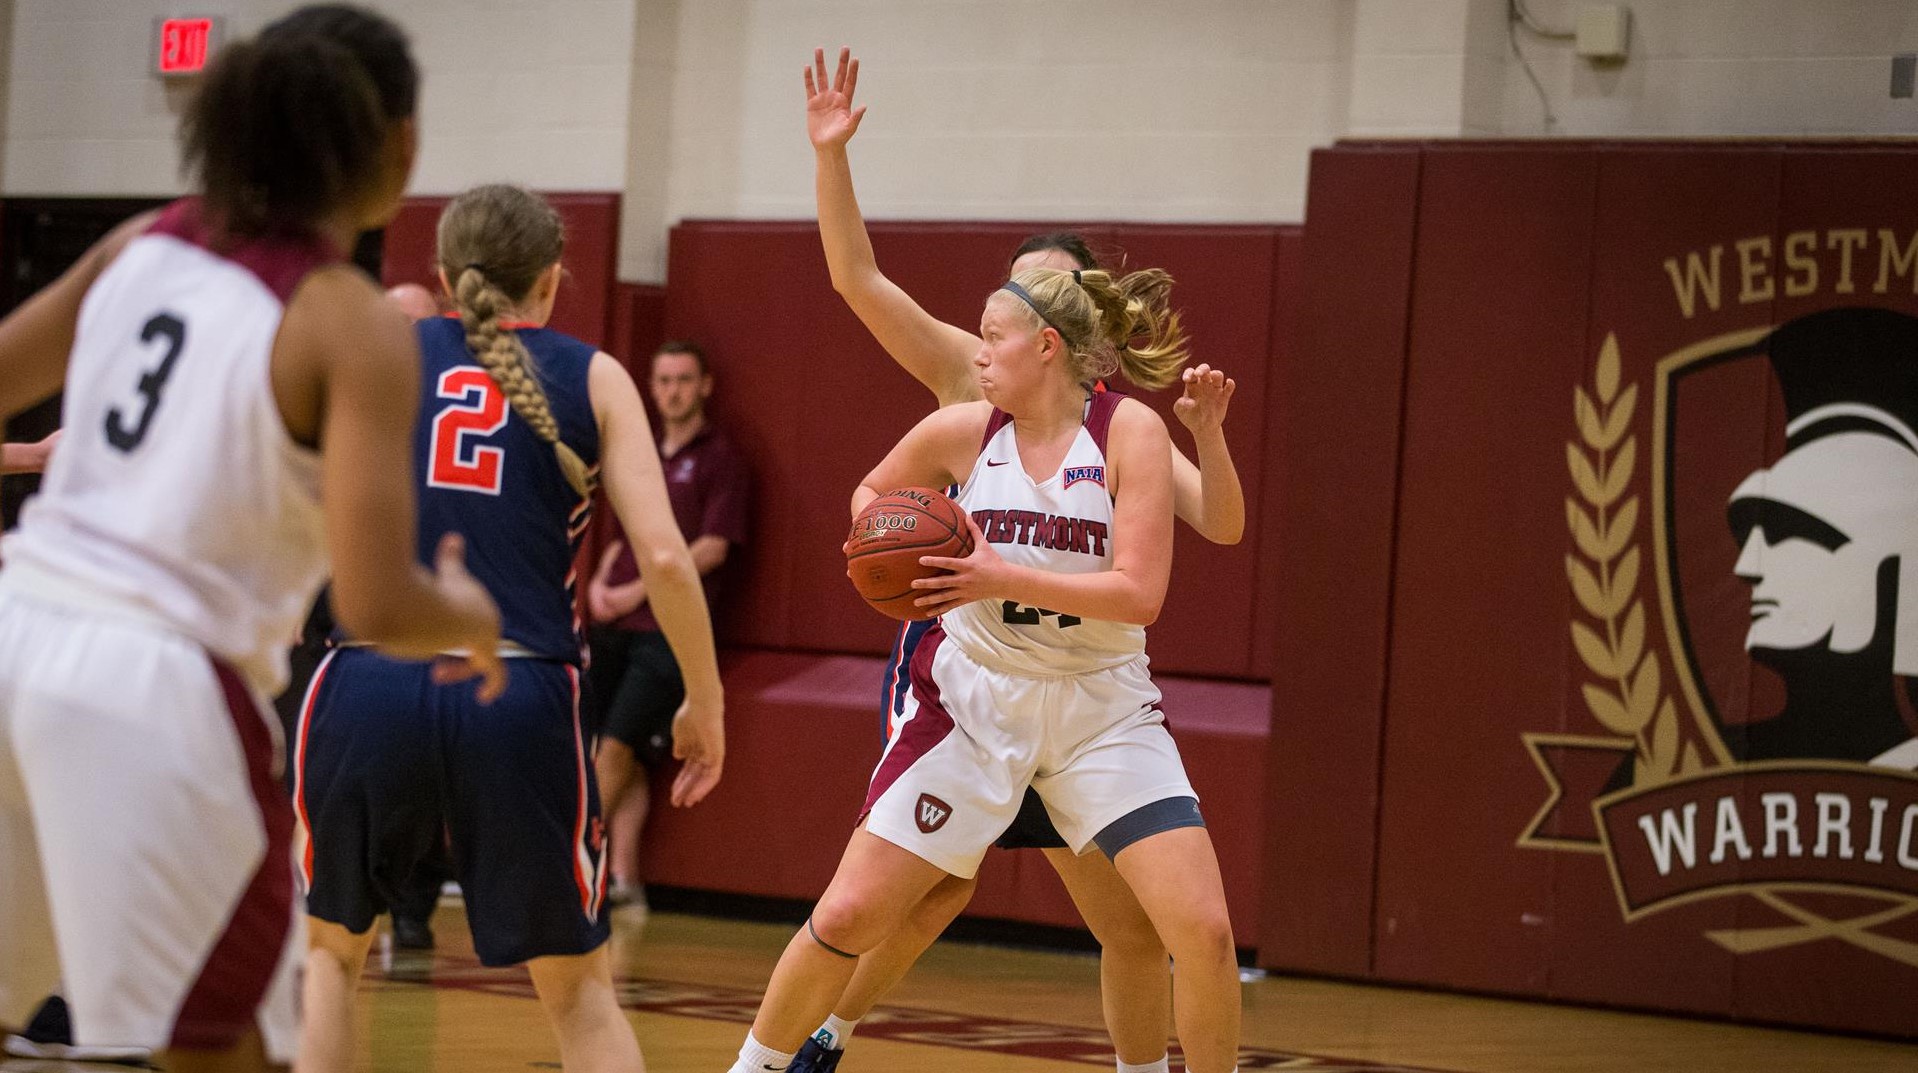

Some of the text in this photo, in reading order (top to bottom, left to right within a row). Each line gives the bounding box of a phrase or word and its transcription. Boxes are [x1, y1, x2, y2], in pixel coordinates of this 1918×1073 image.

[104, 310, 186, 455] 3
[428, 366, 509, 494] 2
[1065, 468, 1103, 485] NAIA
[971, 509, 1108, 557] WESTMONT
